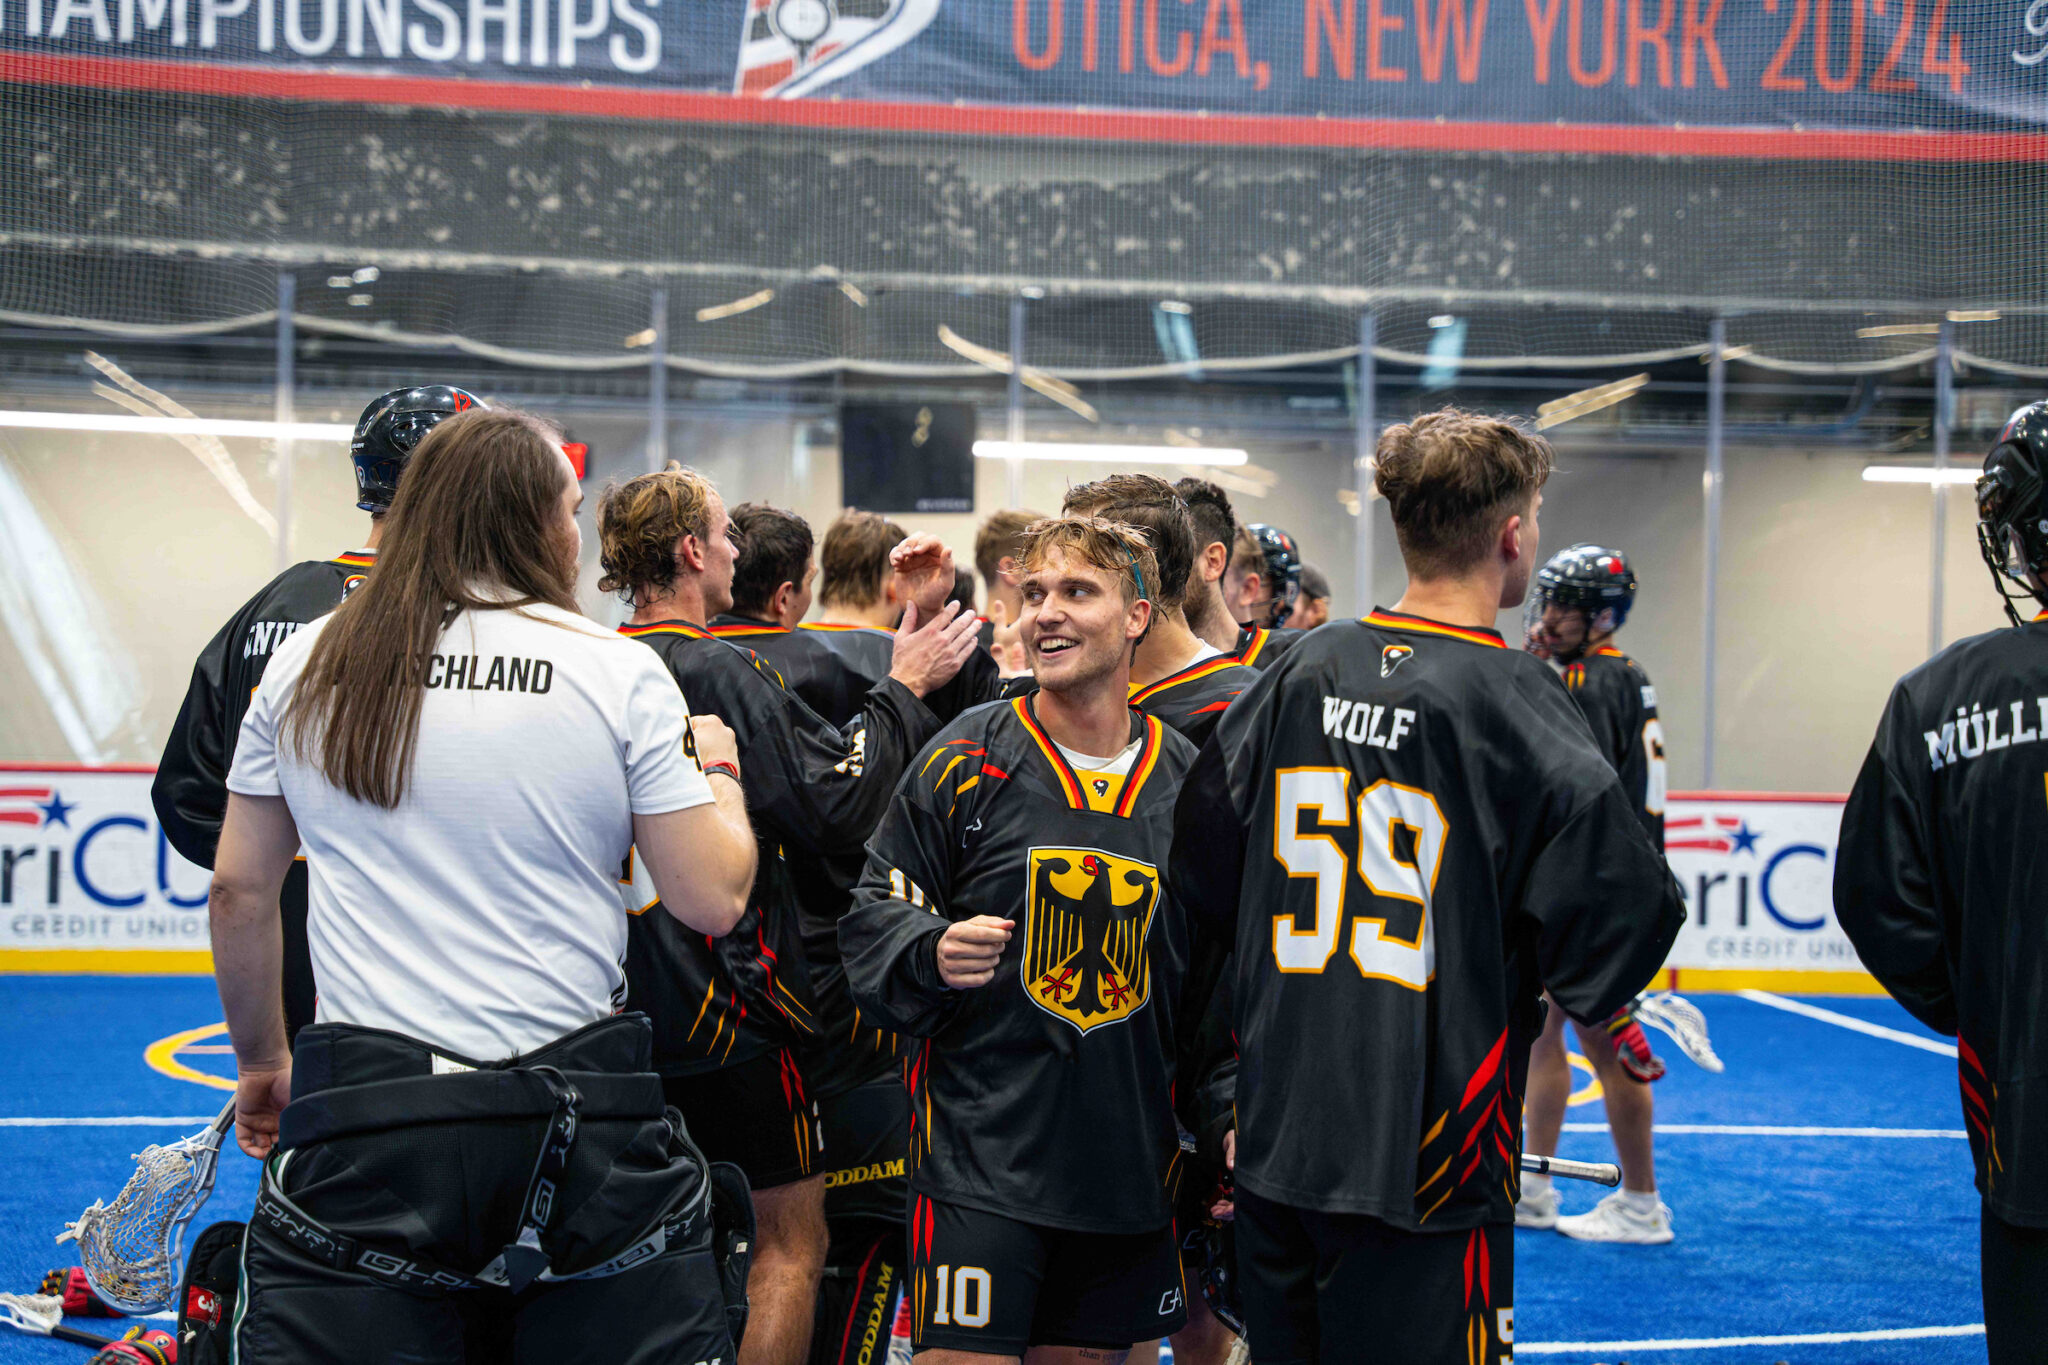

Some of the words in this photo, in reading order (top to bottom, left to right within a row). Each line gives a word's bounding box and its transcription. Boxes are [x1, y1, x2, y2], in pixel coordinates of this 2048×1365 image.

[1303, 0, 1489, 84] NEW
[1526, 0, 1730, 89] YORK
[1760, 0, 1971, 94] 2024
[410, 653, 553, 695] CHLAND
[1322, 696, 1416, 751] WOLF
[1272, 766, 1450, 992] 59
[11, 915, 111, 937] CREDIT
[1706, 937, 1797, 960] CREDIT
[933, 1264, 992, 1328] 10
